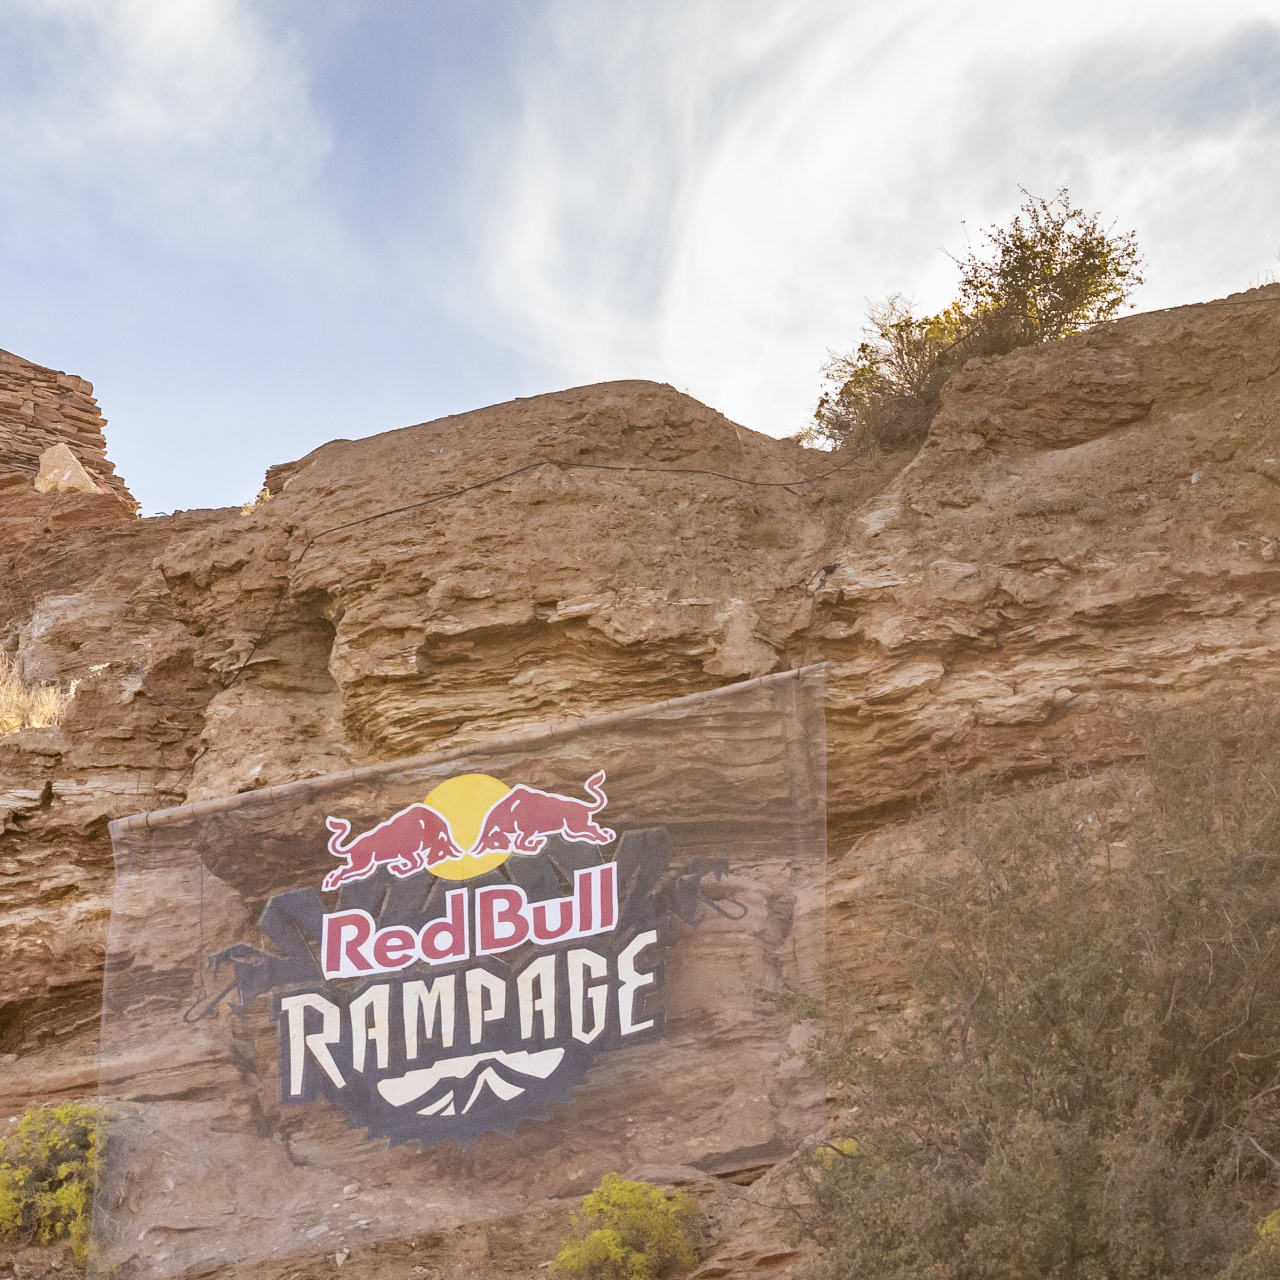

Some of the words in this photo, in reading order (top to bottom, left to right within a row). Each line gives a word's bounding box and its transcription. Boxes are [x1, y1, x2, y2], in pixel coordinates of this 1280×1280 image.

[326, 893, 463, 971] Red
[479, 867, 612, 951] Bull
[281, 929, 657, 1096] RAMPAGE
